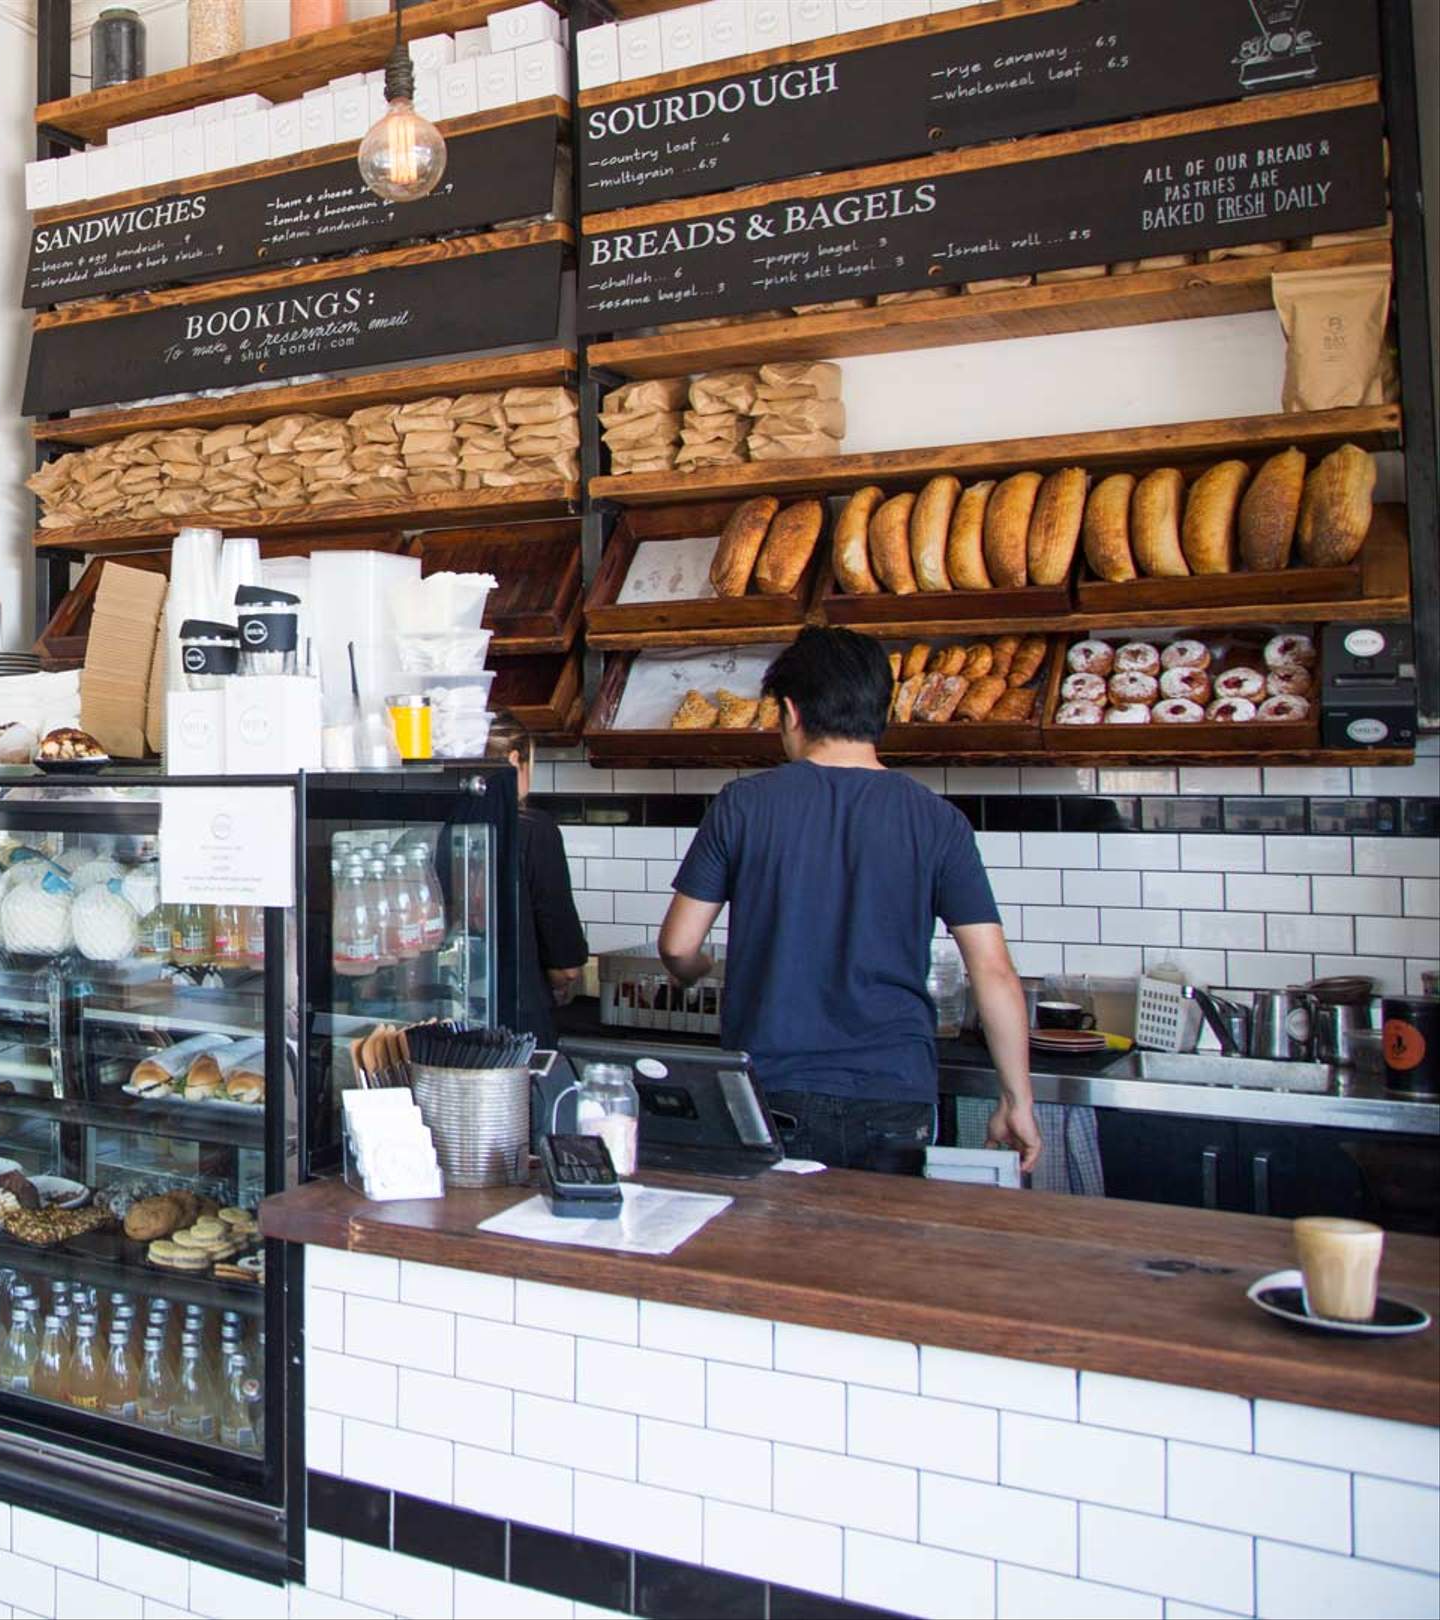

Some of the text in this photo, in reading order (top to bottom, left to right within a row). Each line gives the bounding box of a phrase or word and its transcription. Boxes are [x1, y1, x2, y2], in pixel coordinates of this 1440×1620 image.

[993, 47, 1067, 69] caraway
[1048, 61, 1083, 80] loaf
[588, 62, 839, 140] SOURDOUGH
[666, 136, 697, 154] loaf
[1143, 140, 1330, 184] ALL OF OUR BREADS &
[317, 186, 354, 202] cheese
[1164, 169, 1279, 202] PASTRIES ARE
[1142, 181, 1331, 231] BAKED FRESH DAILY
[35, 196, 207, 254] SANDWICHES
[589, 184, 937, 266] BREADS & BAGELS
[818, 239, 859, 257] bagel
[1011, 232, 1042, 249] roll
[88, 253, 108, 266] egg
[804, 264, 833, 281] salt
[838, 258, 878, 277] bagel
[674, 266, 683, 278] 6
[184, 287, 376, 340] BOOKINGS:
[163, 344, 184, 364] To
[191, 341, 229, 358] make
[239, 339, 251, 351] a
[240, 347, 271, 363] shuk
